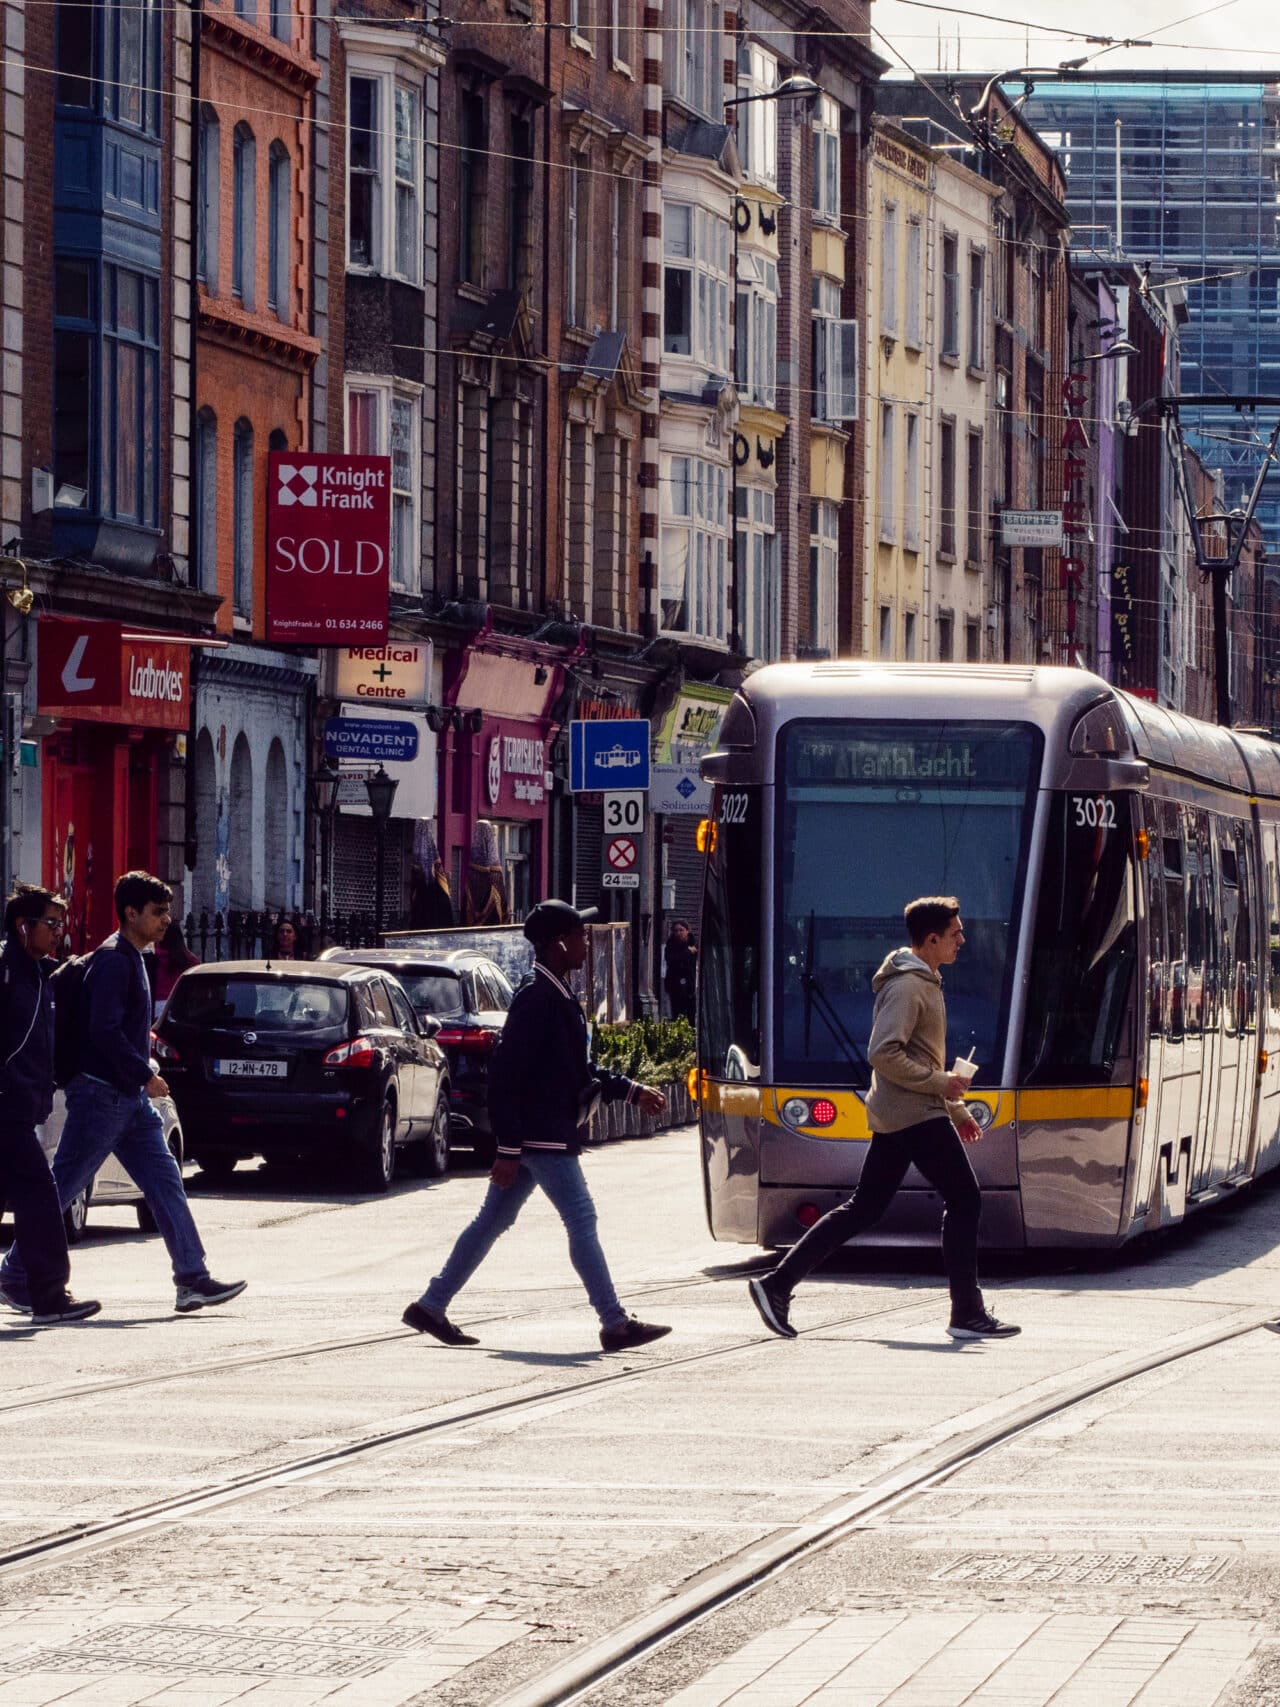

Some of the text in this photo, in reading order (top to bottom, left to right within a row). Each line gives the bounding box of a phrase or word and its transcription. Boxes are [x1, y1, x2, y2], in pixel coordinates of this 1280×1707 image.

[322, 466, 385, 491] Knight
[322, 489, 375, 510] Frank
[275, 536, 384, 576] SOLD
[325, 618, 338, 629] 01
[339, 619, 357, 629] 634
[359, 619, 384, 630] 2466
[348, 647, 419, 663] Medical
[129, 655, 183, 702] Ladbrokes
[356, 683, 407, 698] Centre
[325, 730, 416, 747] NOVADENT
[335, 744, 405, 757] DENTAL CLINIC
[607, 799, 640, 827] 30
[660, 800, 710, 811] Solicitors
[719, 793, 749, 824] 3022
[1073, 796, 1117, 828] 3022
[604, 874, 621, 886] 24
[228, 1062, 278, 1075] 12-MN-478
